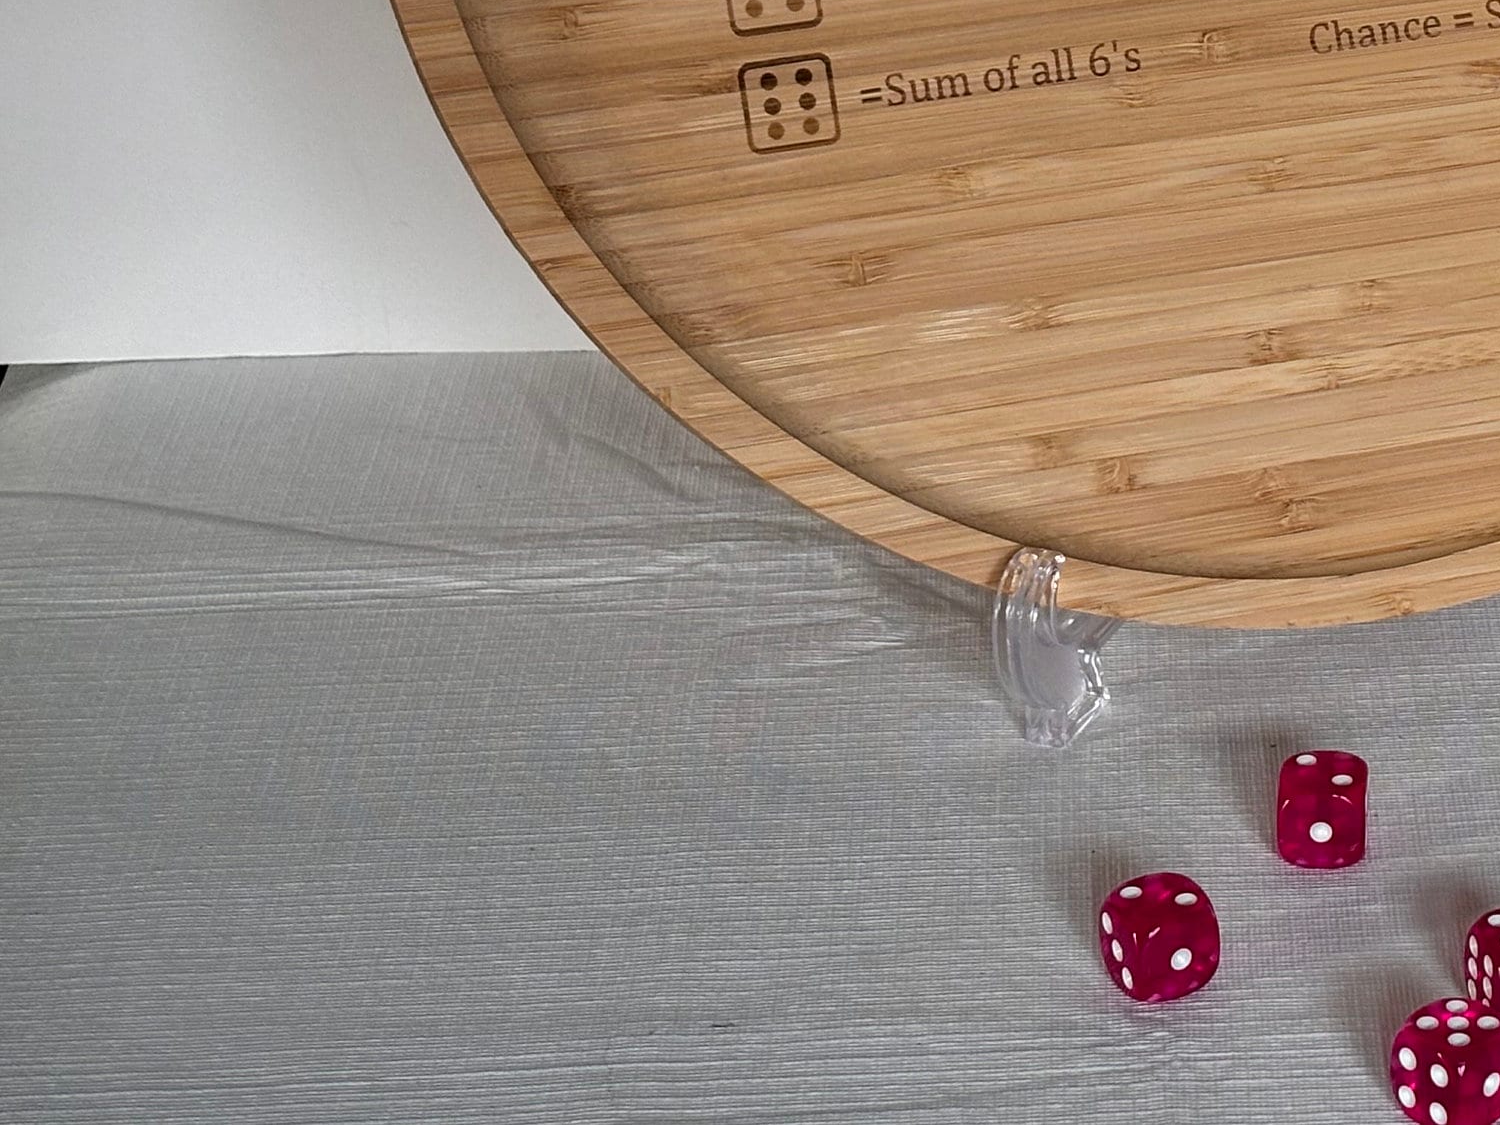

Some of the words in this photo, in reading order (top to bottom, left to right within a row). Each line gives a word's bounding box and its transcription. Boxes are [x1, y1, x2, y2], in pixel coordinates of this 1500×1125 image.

[1309, 10, 1442, 54] Chance
[1453, 11, 1475, 28] =
[860, 72, 972, 108] =Sum
[983, 55, 1020, 93] of
[1032, 48, 1077, 86] all
[1088, 41, 1141, 78] 6's
